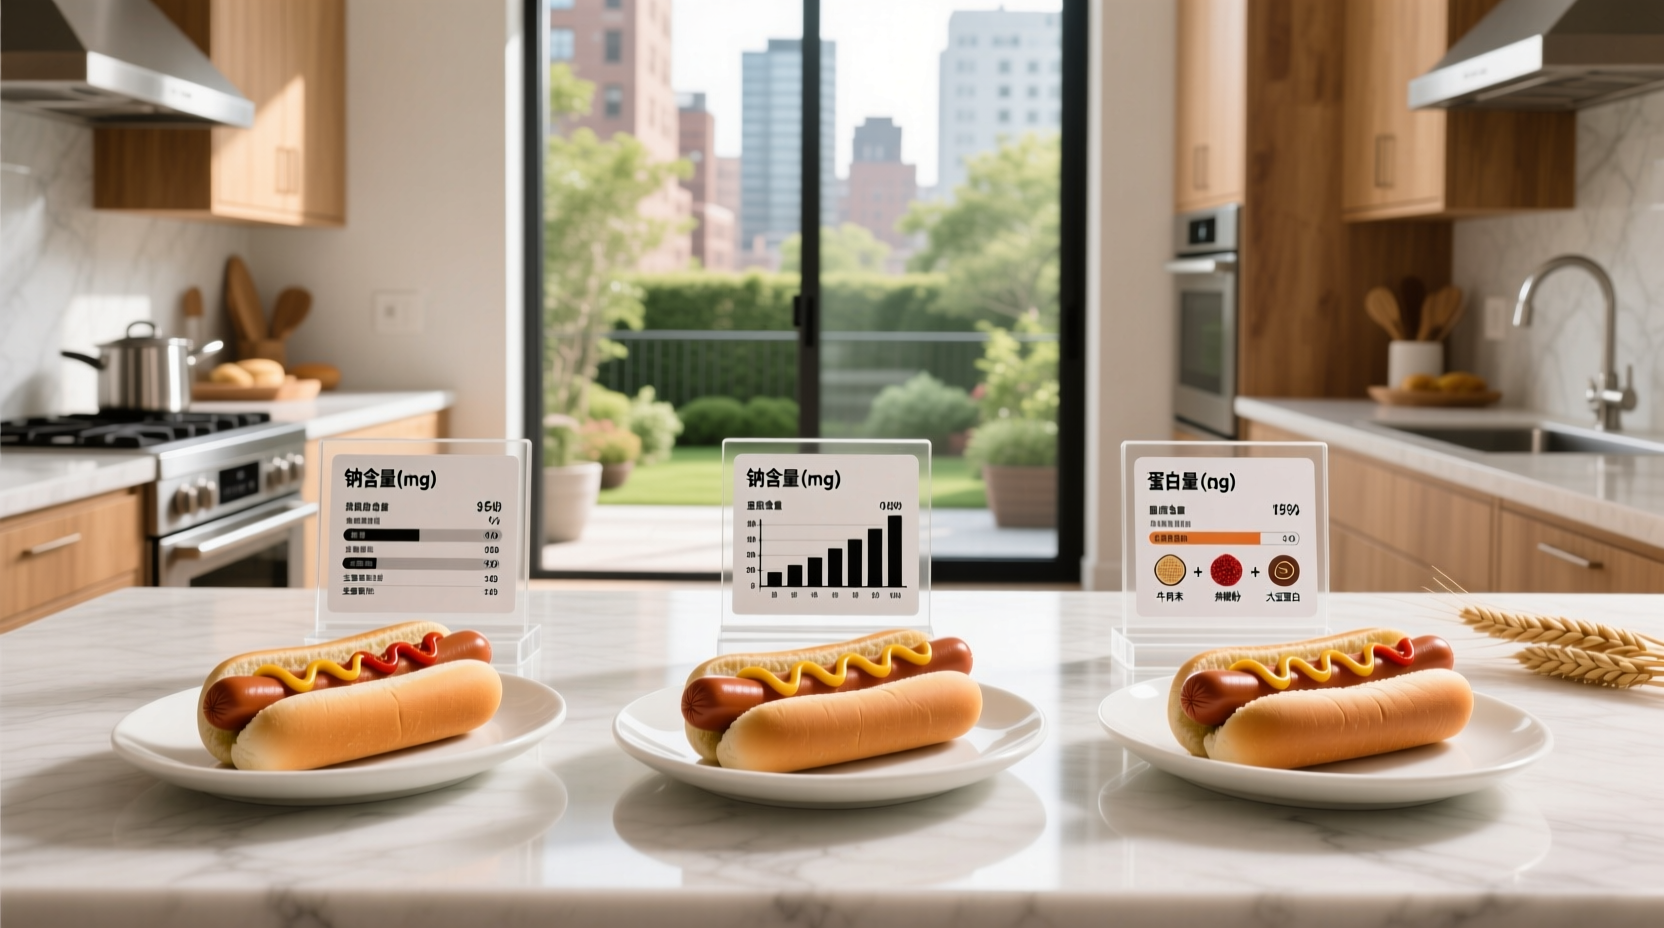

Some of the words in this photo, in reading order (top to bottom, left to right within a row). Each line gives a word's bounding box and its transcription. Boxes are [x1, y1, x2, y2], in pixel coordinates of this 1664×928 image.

[344, 468, 436, 490] 钠含量(mg)
[747, 468, 840, 490] 钠含量(mg)
